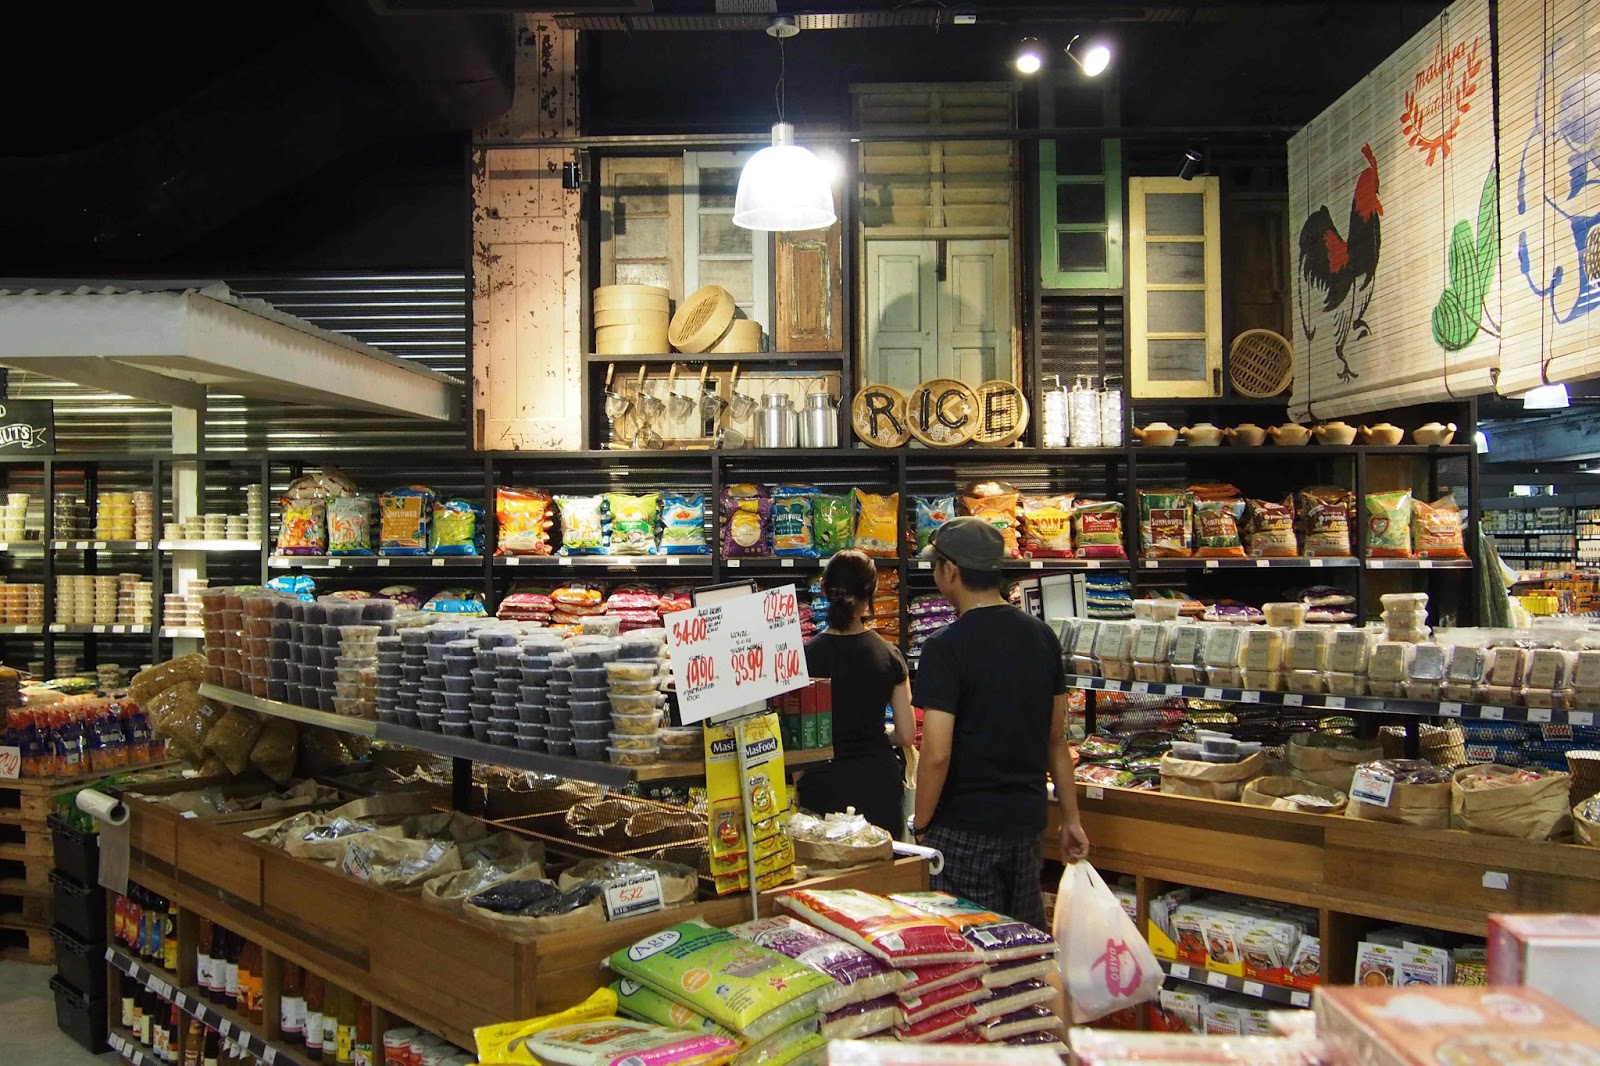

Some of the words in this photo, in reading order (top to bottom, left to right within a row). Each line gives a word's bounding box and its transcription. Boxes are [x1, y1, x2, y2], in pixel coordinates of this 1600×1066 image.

[865, 388, 1017, 438] RICE
[673, 617, 707, 647] 34.00
[686, 655, 714, 689] 19.90
[713, 741, 737, 754] MasF
[745, 739, 776, 757] MasFood
[634, 931, 676, 957] Agra
[1108, 947, 1120, 981] DAISO
